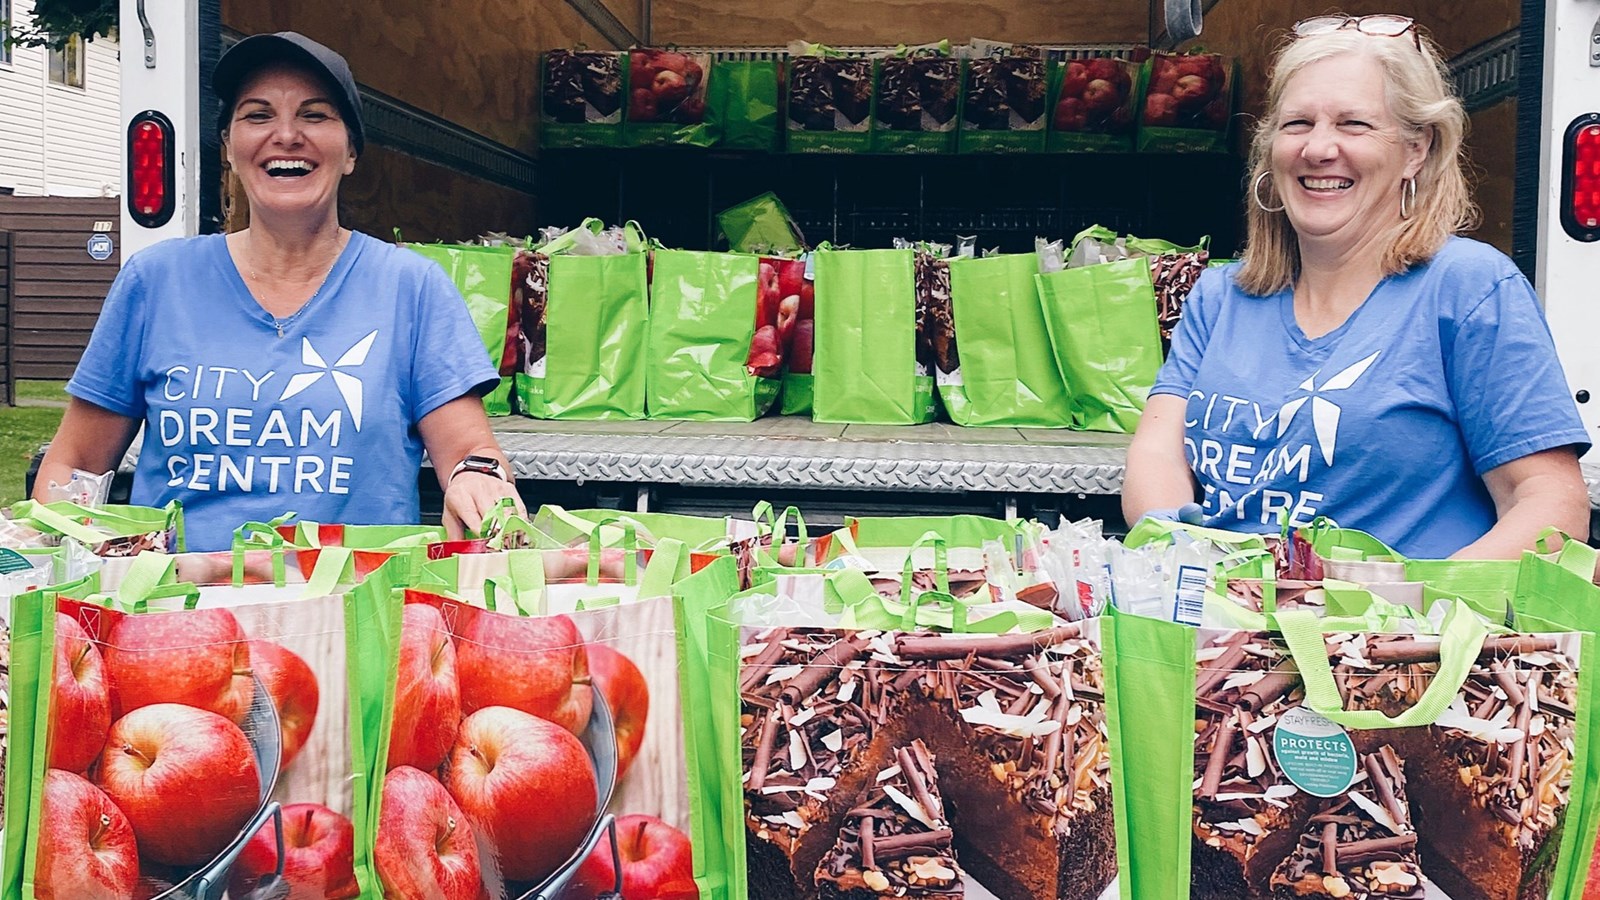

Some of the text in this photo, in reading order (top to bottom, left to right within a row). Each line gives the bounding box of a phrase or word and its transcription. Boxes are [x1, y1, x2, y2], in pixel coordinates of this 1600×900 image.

[164, 365, 276, 401] CITY
[160, 408, 342, 447] DREAM
[1184, 390, 1279, 440] CITY
[167, 454, 354, 494] CENTRE
[1281, 738, 1347, 752] PROTECTS
